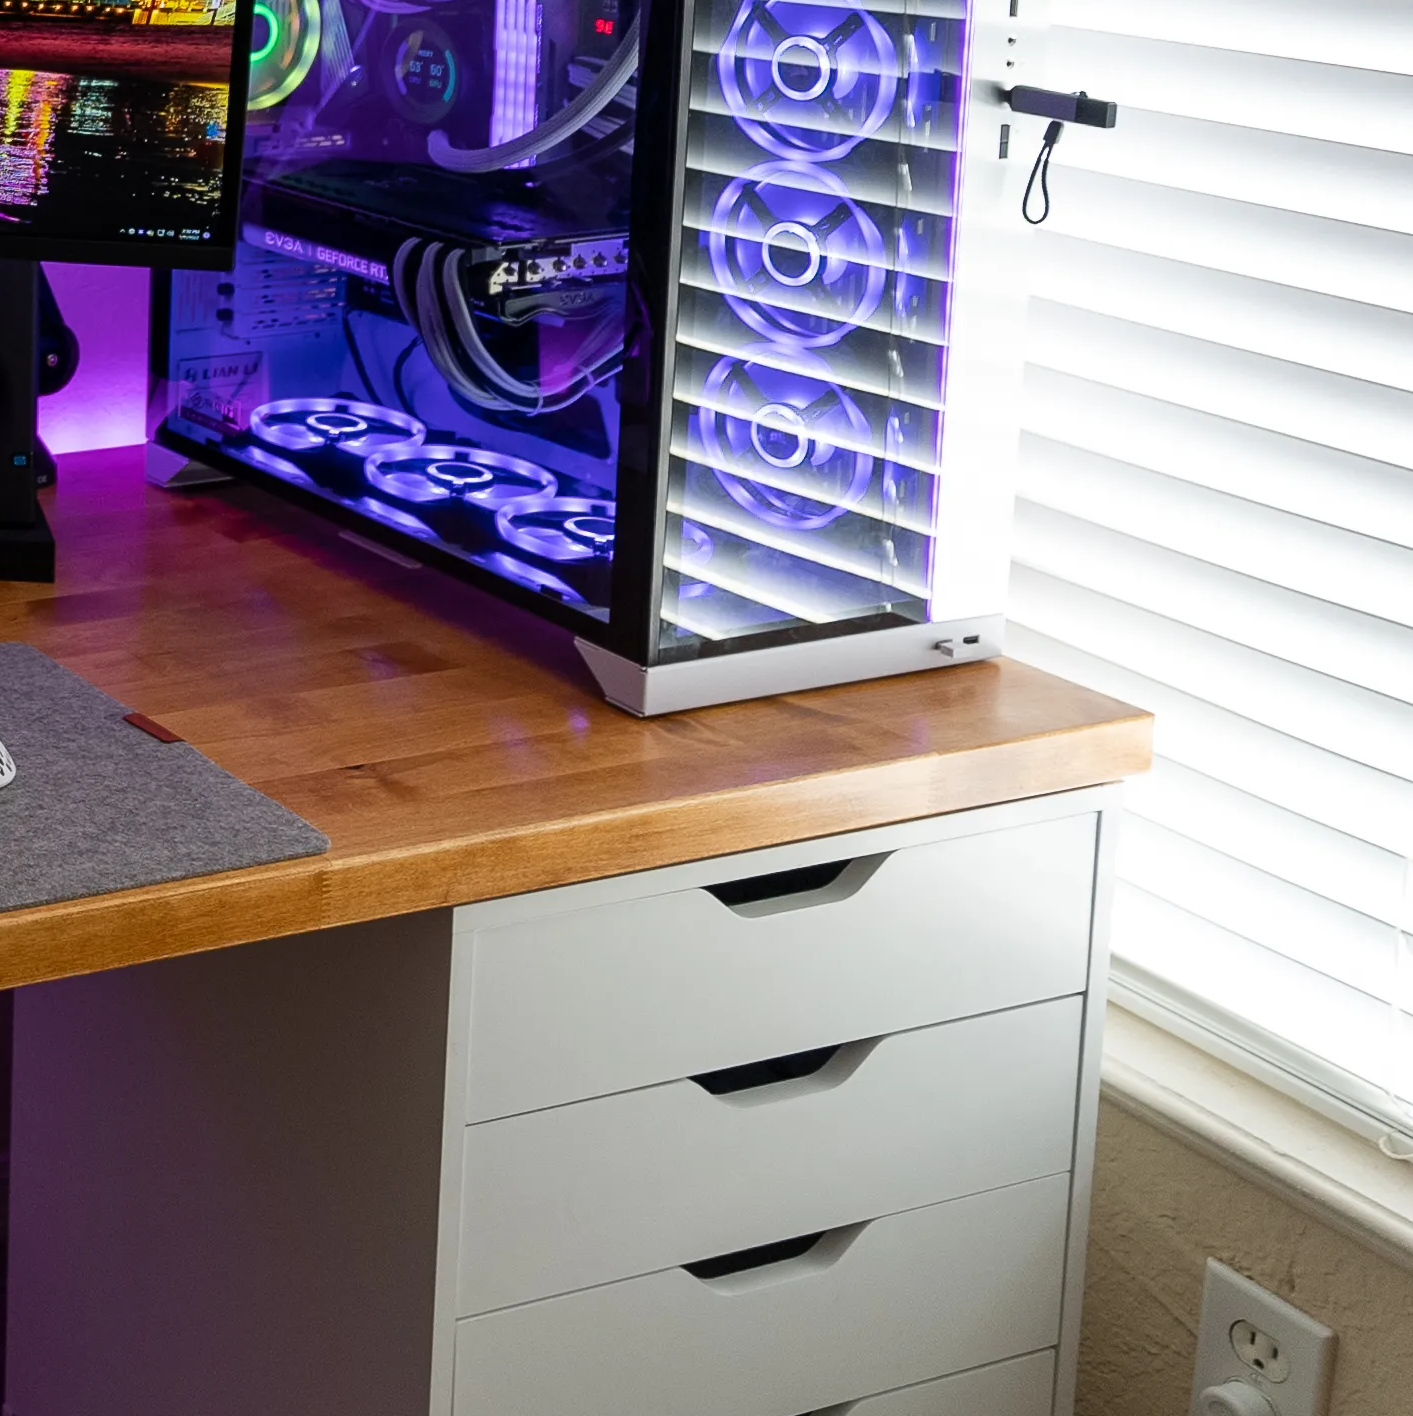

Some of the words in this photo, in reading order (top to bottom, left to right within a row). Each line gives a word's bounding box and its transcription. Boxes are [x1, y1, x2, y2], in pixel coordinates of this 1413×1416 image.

[317, 246, 368, 274] GEFORCE
[370, 262, 389, 281] RT
[203, 366, 239, 379] LIAN
